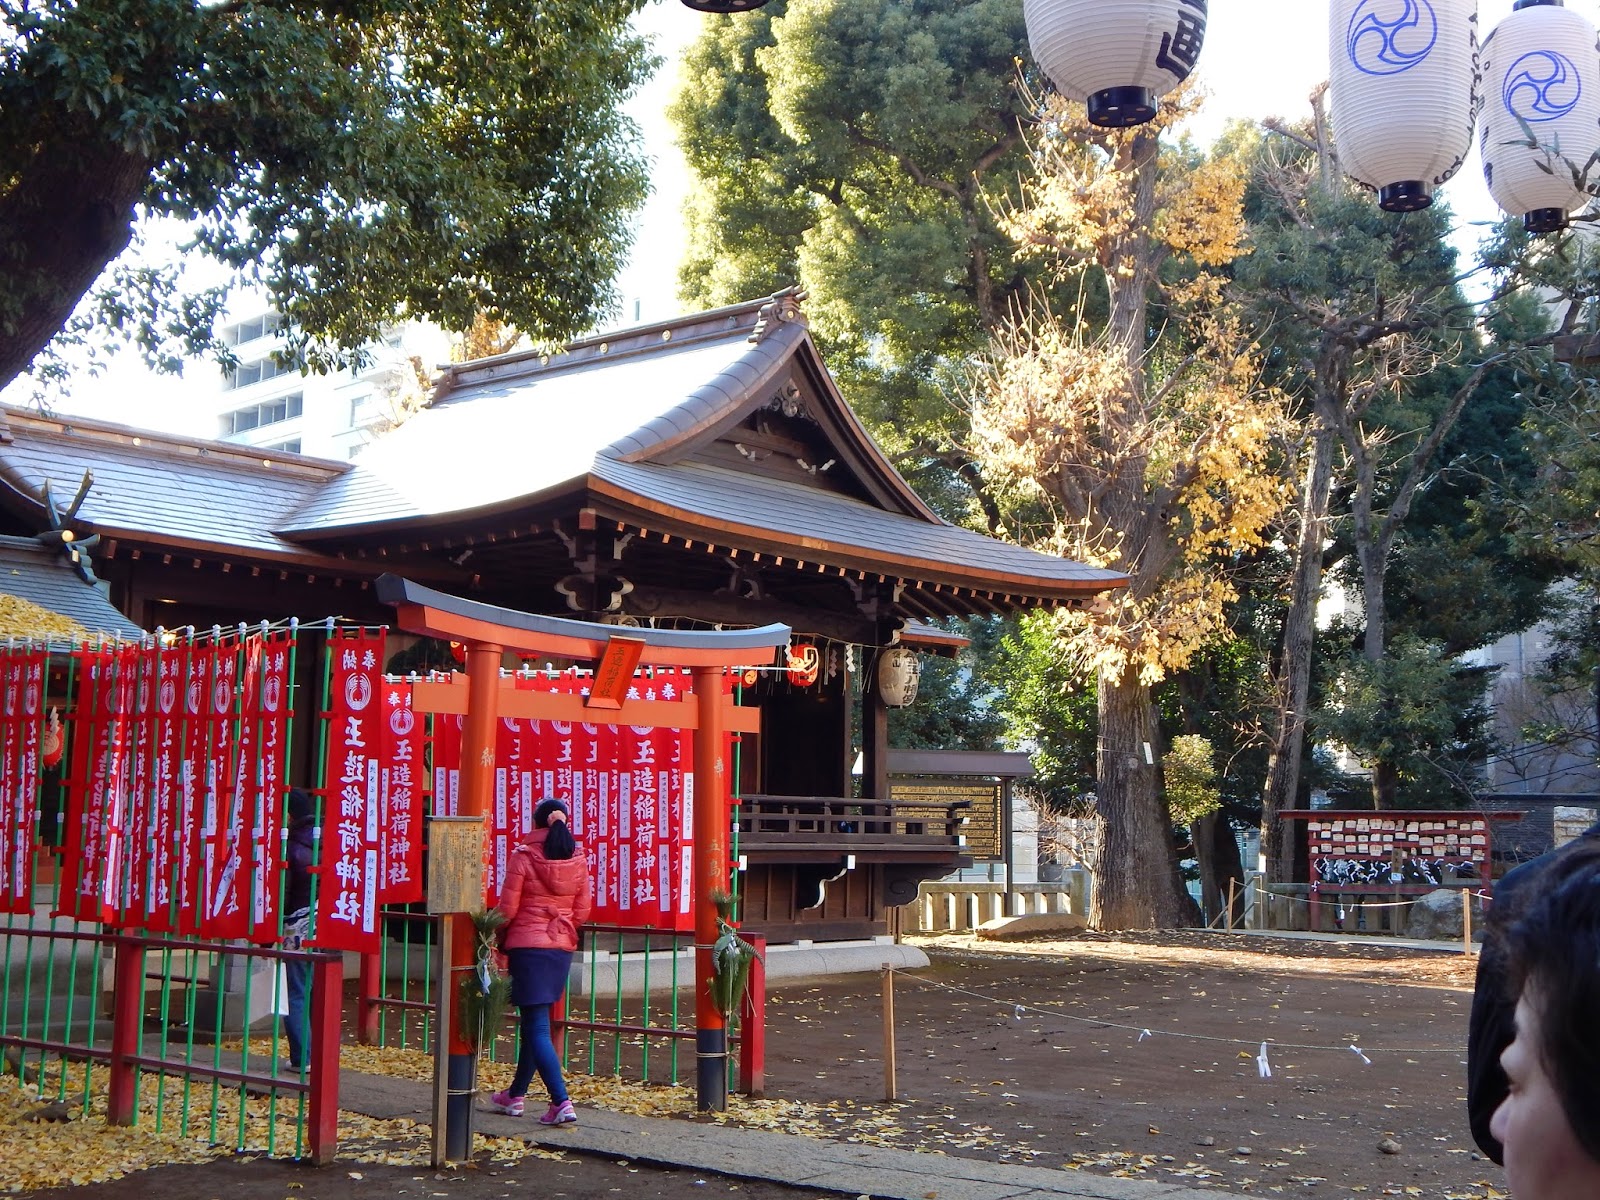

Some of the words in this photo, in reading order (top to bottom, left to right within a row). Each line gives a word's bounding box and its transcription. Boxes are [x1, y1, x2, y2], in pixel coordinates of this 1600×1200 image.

[1156, 0, 1208, 84] 通
[388, 738, 414, 886] 玉造稲荷神社
[632, 739, 657, 906] 玉造稲荷神社
